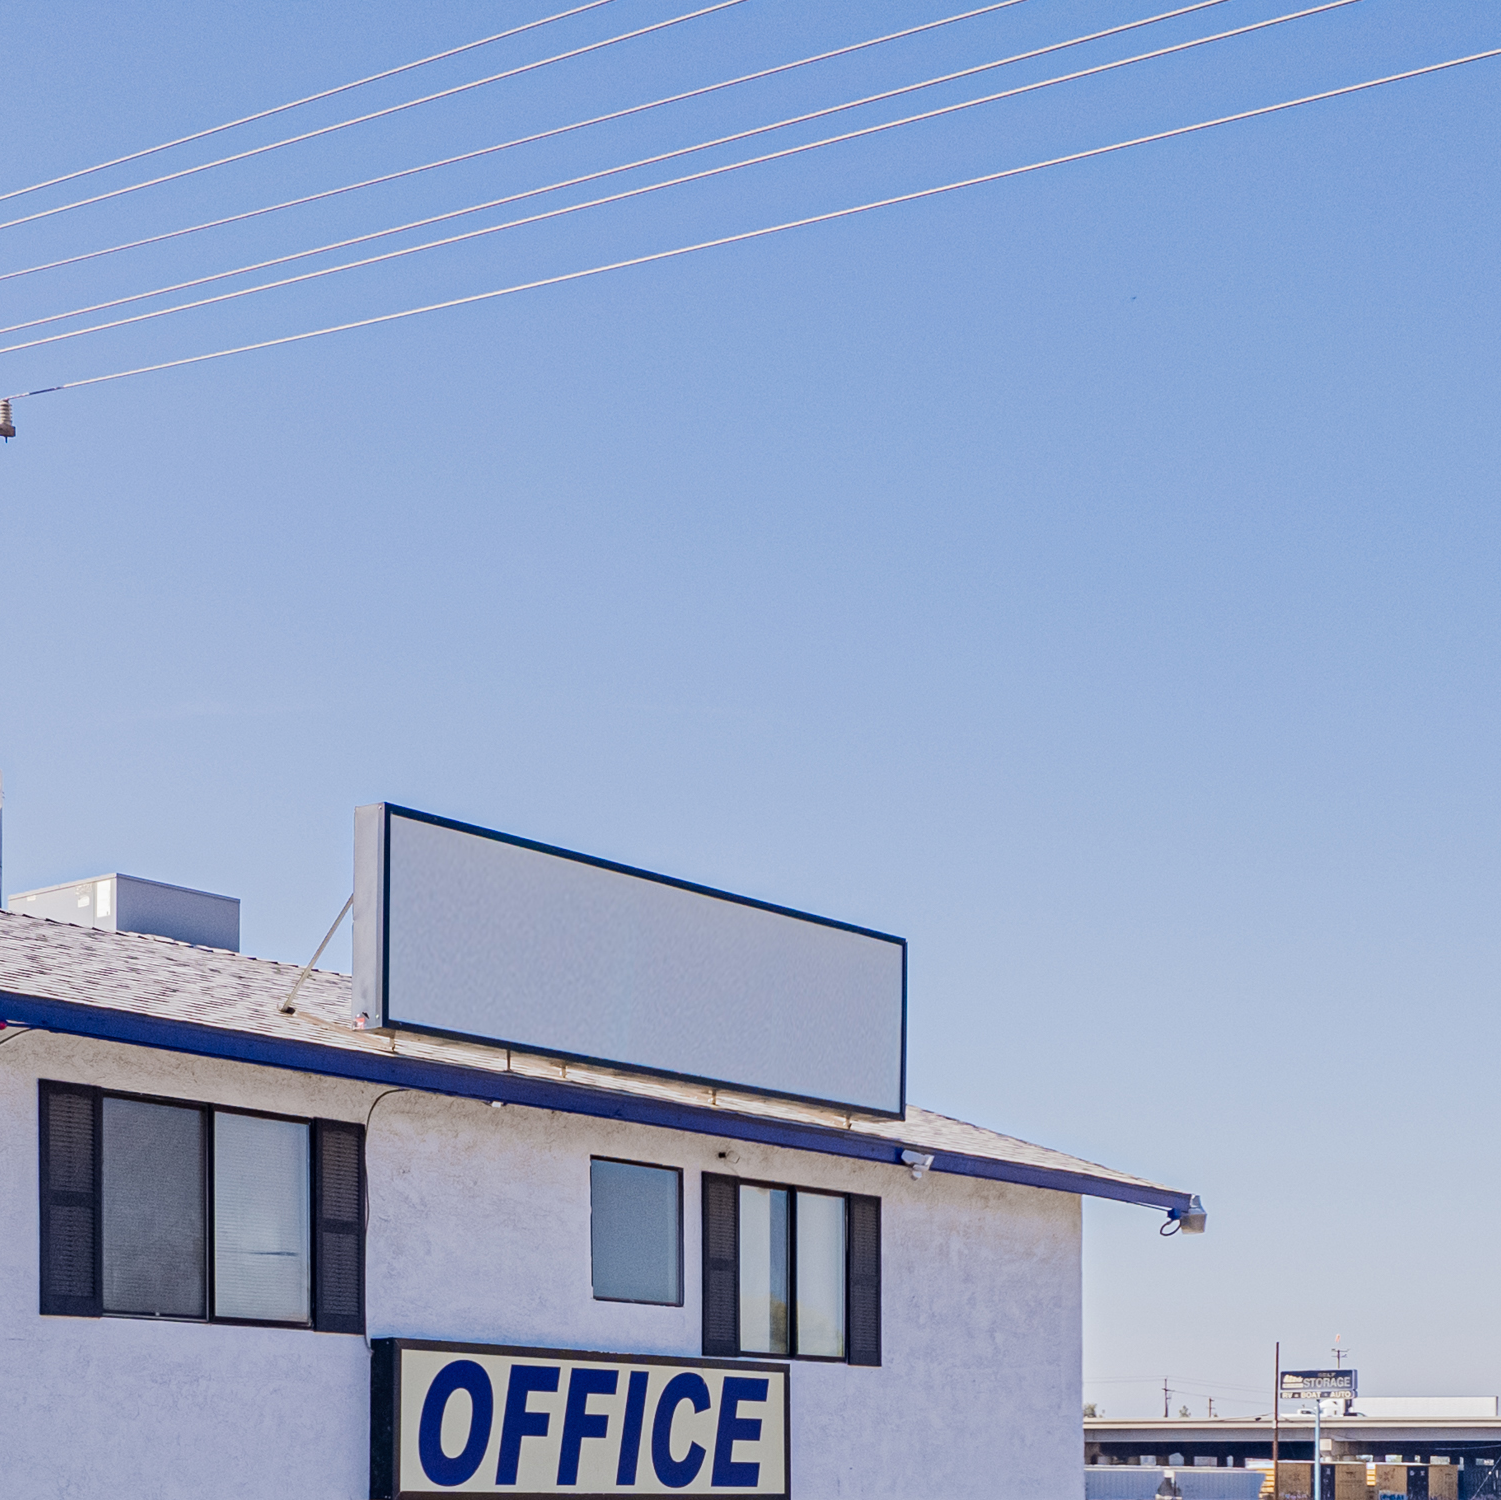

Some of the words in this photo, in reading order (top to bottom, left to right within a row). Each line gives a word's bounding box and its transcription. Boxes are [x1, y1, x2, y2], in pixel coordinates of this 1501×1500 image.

[1303, 1377, 1351, 1388] STORAGE
[1282, 1391, 1293, 1399] RV
[418, 1359, 770, 1488] OFFICE
